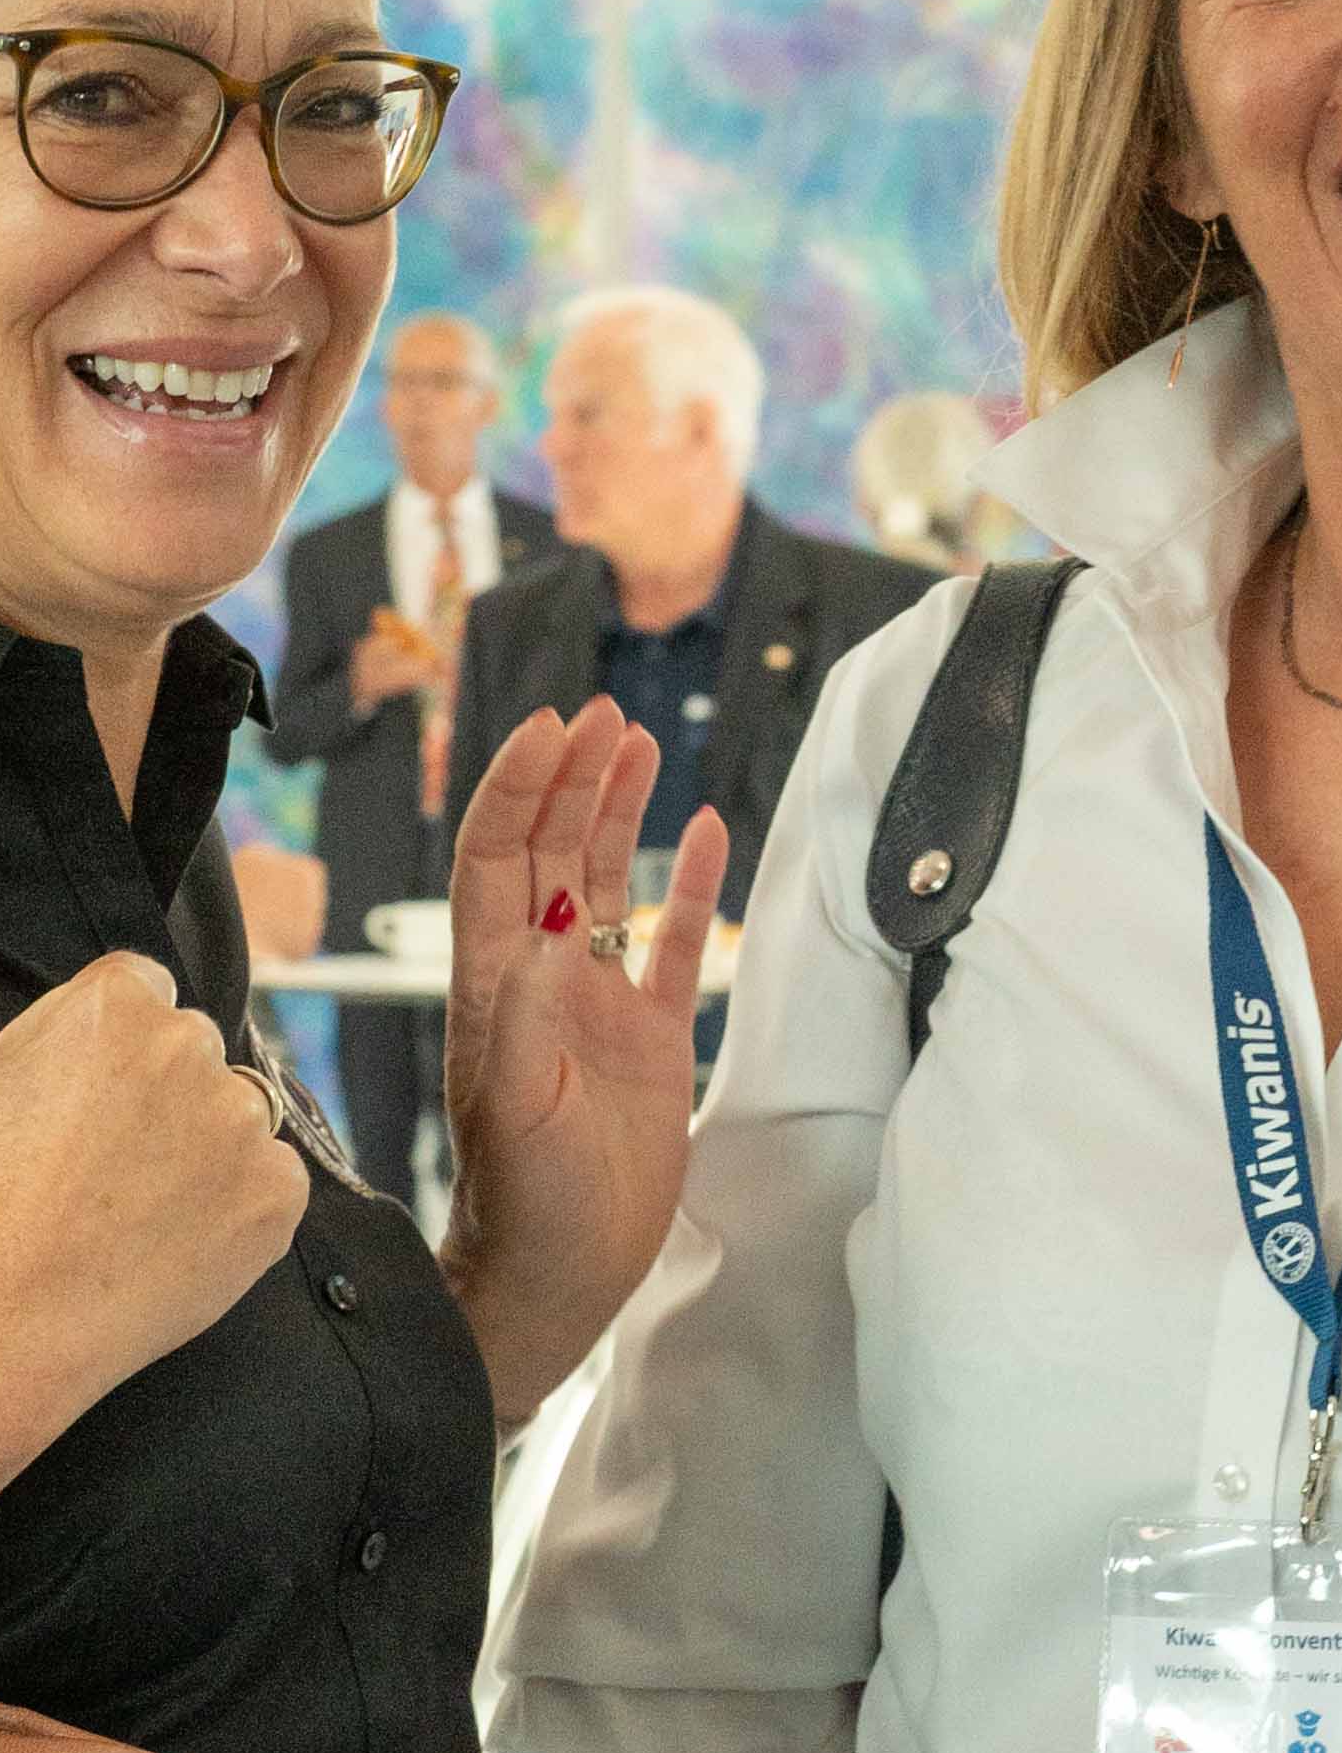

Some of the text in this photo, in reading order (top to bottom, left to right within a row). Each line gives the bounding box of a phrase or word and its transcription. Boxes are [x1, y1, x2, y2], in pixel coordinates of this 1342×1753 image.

[1227, 994, 1303, 1217] Kiwanis
[1166, 1626, 1217, 1647] Kiwa
[1155, 1664, 1220, 1683] Wichtige
[1306, 1669, 1330, 1684] wir
